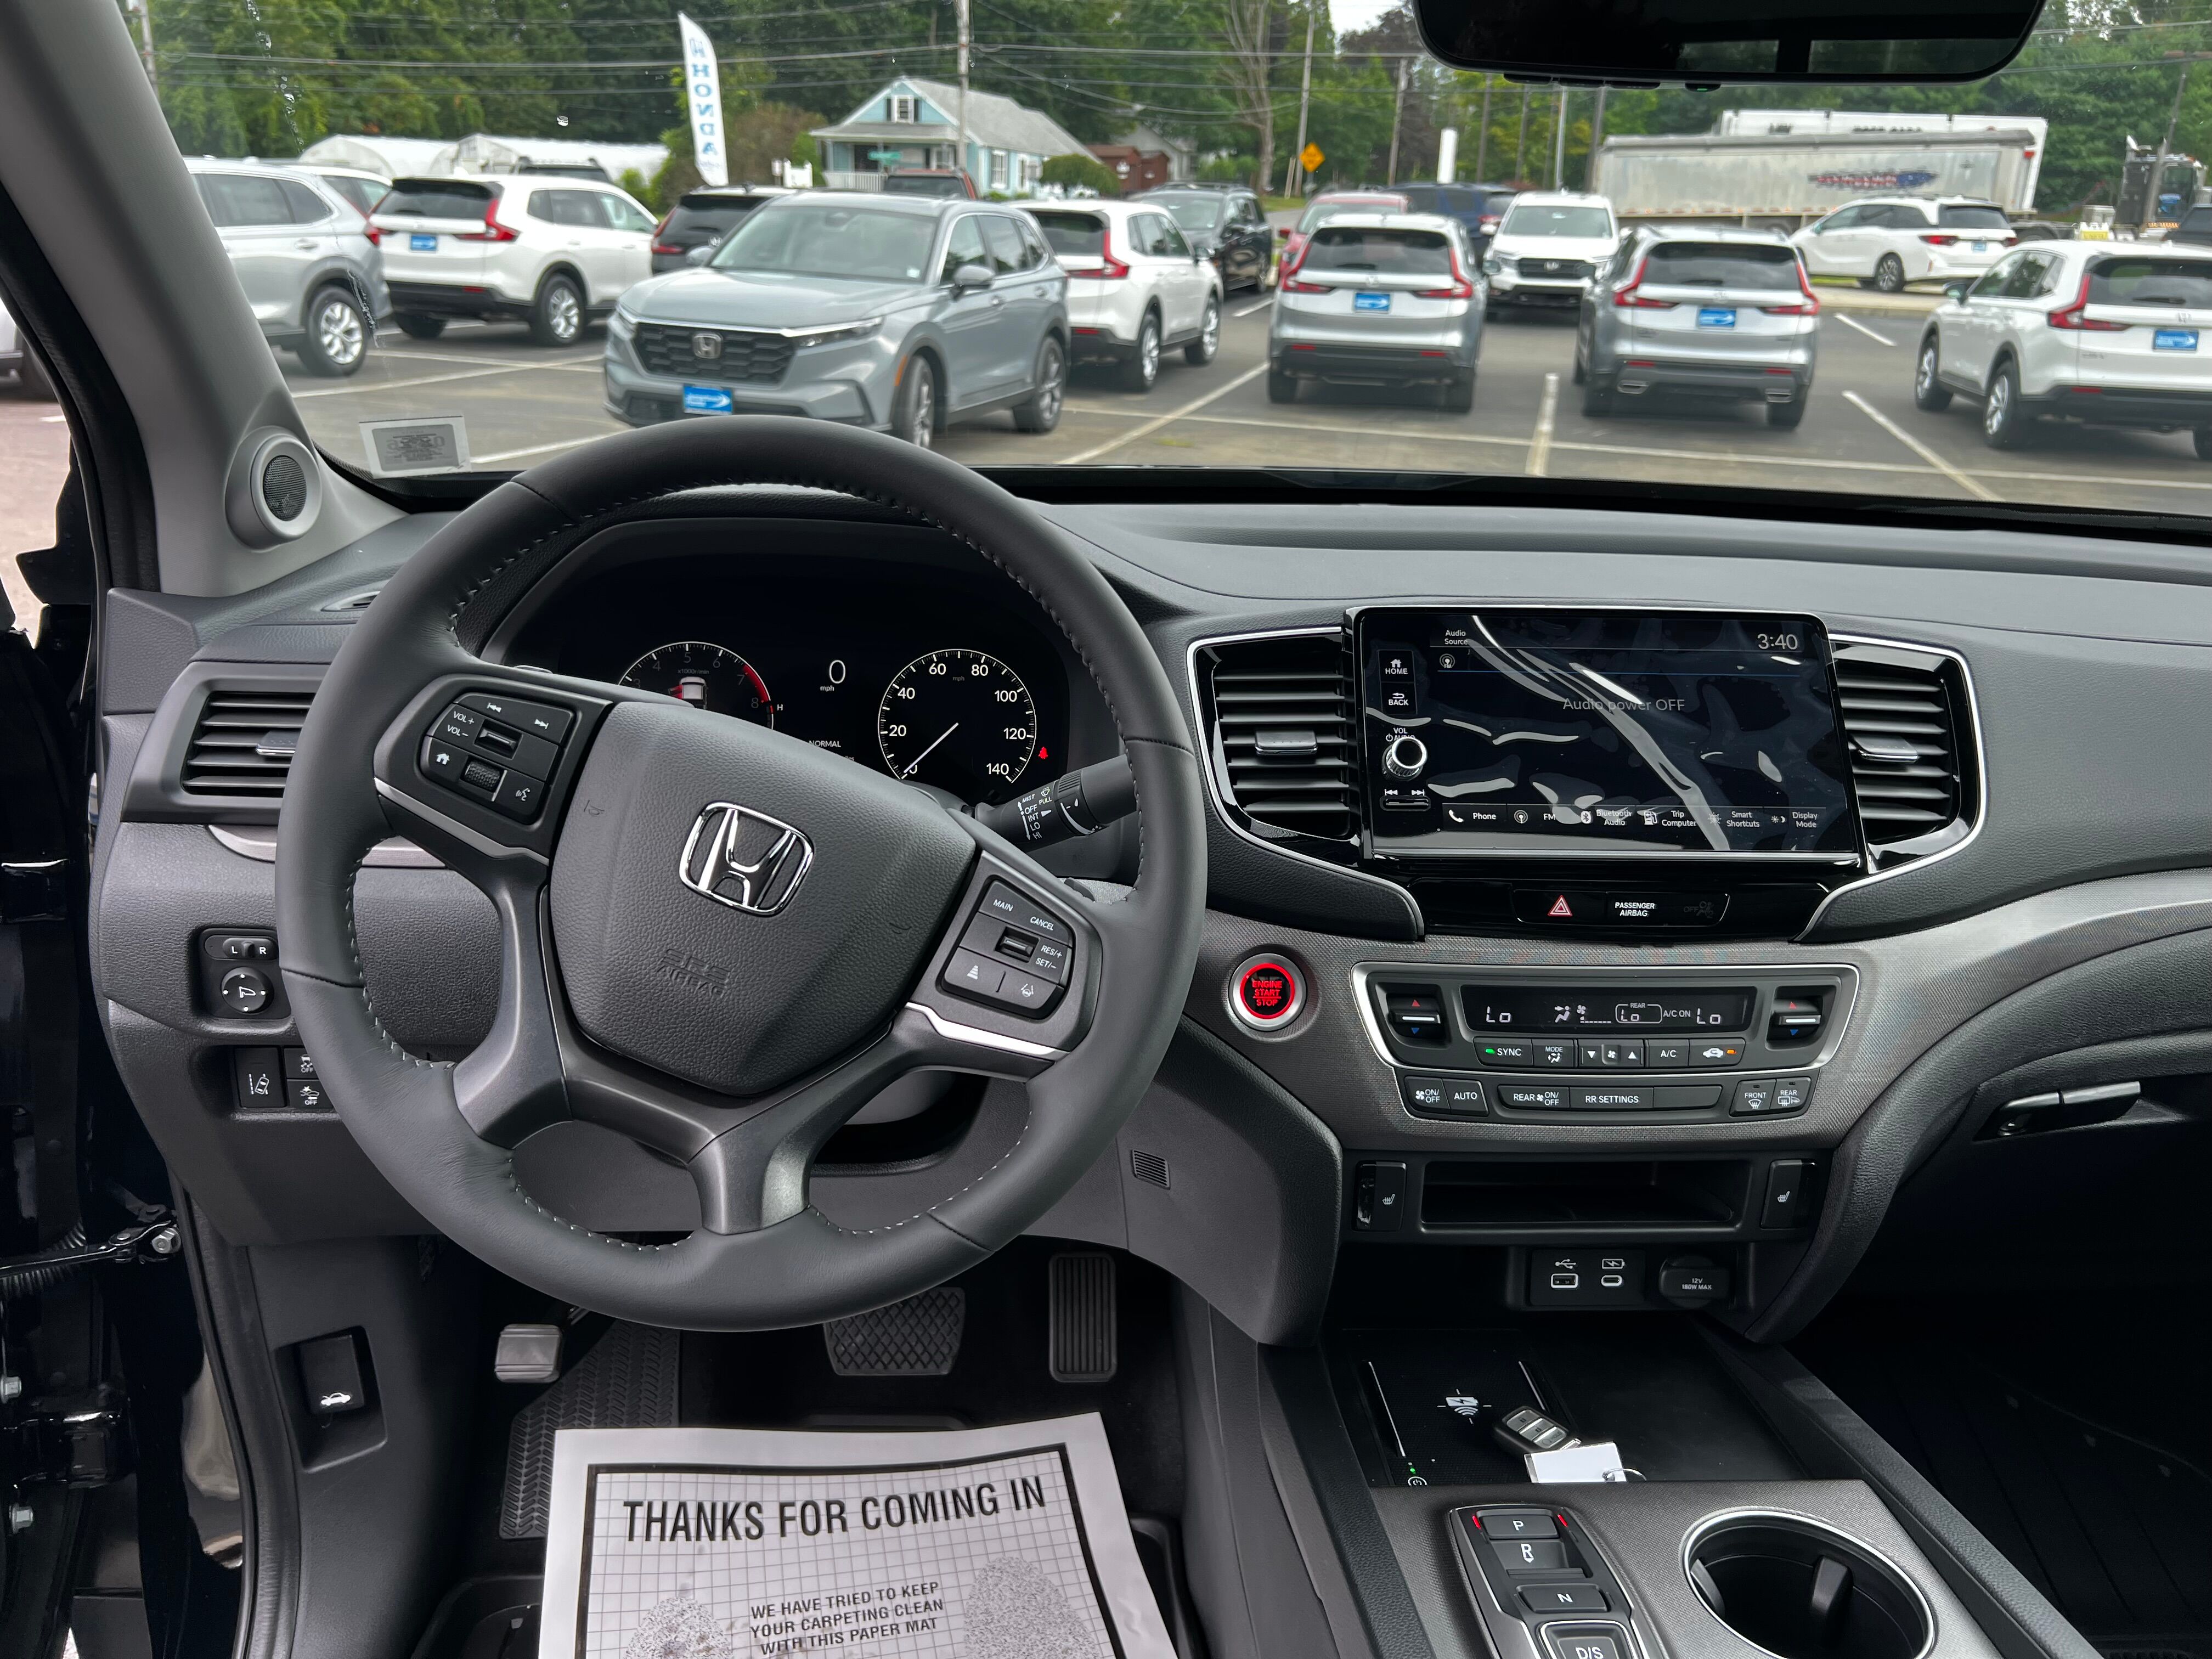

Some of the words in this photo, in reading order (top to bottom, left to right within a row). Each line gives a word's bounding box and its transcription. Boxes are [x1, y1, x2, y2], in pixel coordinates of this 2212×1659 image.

[1757, 634, 1798, 650] 3:40
[828, 659, 846, 684] 0
[928, 663, 946, 675] 60
[971, 664, 989, 676] 80
[897, 687, 915, 699] 40
[994, 690, 1018, 702] 100
[1563, 698, 1603, 711] Audio
[1608, 699, 1651, 714] power
[1655, 699, 1685, 712] OFF
[889, 725, 907, 737] 20
[1003, 727, 1026, 740] 120
[986, 763, 1009, 775] 140
[1022, 793, 1036, 804] MIST
[1039, 797, 1053, 806] PULL
[1025, 804, 1038, 815] OFF
[1596, 809, 1633, 817] Bluetooth
[1671, 810, 1685, 819] Trip
[1028, 812, 1040, 822] INT
[1472, 812, 1497, 820] Phone
[1792, 811, 1818, 820] Display
[1029, 822, 1041, 831] LO
[1726, 820, 1760, 828] Shortcuts
[1033, 832, 1042, 840] HI
[993, 899, 1014, 912] MAIN
[1030, 916, 1054, 931] CANCEL
[231, 946, 238, 954] L
[259, 946, 267, 955] R
[1679, 1009, 1691, 1018] ON
[1497, 1048, 1522, 1057] SYNC
[1660, 1049, 1677, 1058] A/C
[1425, 1088, 1440, 1097] ON/
[1454, 1092, 1477, 1100] AUTO
[1585, 1095, 1598, 1103] RR
[1599, 1095, 1639, 1103] SETTINGS
[623, 1499, 764, 1543] THANKS
[778, 1499, 848, 1537] FOR
[861, 1483, 1000, 1531] COMING
[1010, 1475, 1046, 1510] IN
[1513, 1520, 1524, 1531] P
[1520, 1543, 1533, 1558] R
[751, 1604, 776, 1620] WE
[781, 1598, 822, 1616] HAVE
[826, 1592, 871, 1609] TRIED
[876, 1588, 896, 1601] TO
[901, 1582, 939, 1597] KEEP
[1557, 1593, 1573, 1602] N
[749, 1621, 795, 1639] YOUR
[801, 1606, 889, 1630] CARPETING
[895, 1599, 944, 1617] CLEAN
[760, 1637, 805, 1656] WITH
[809, 1632, 845, 1647] THIS
[850, 1623, 900, 1642] PAPER
[906, 1617, 939, 1633] MAT
[1575, 1646, 1605, 1659] D/S
